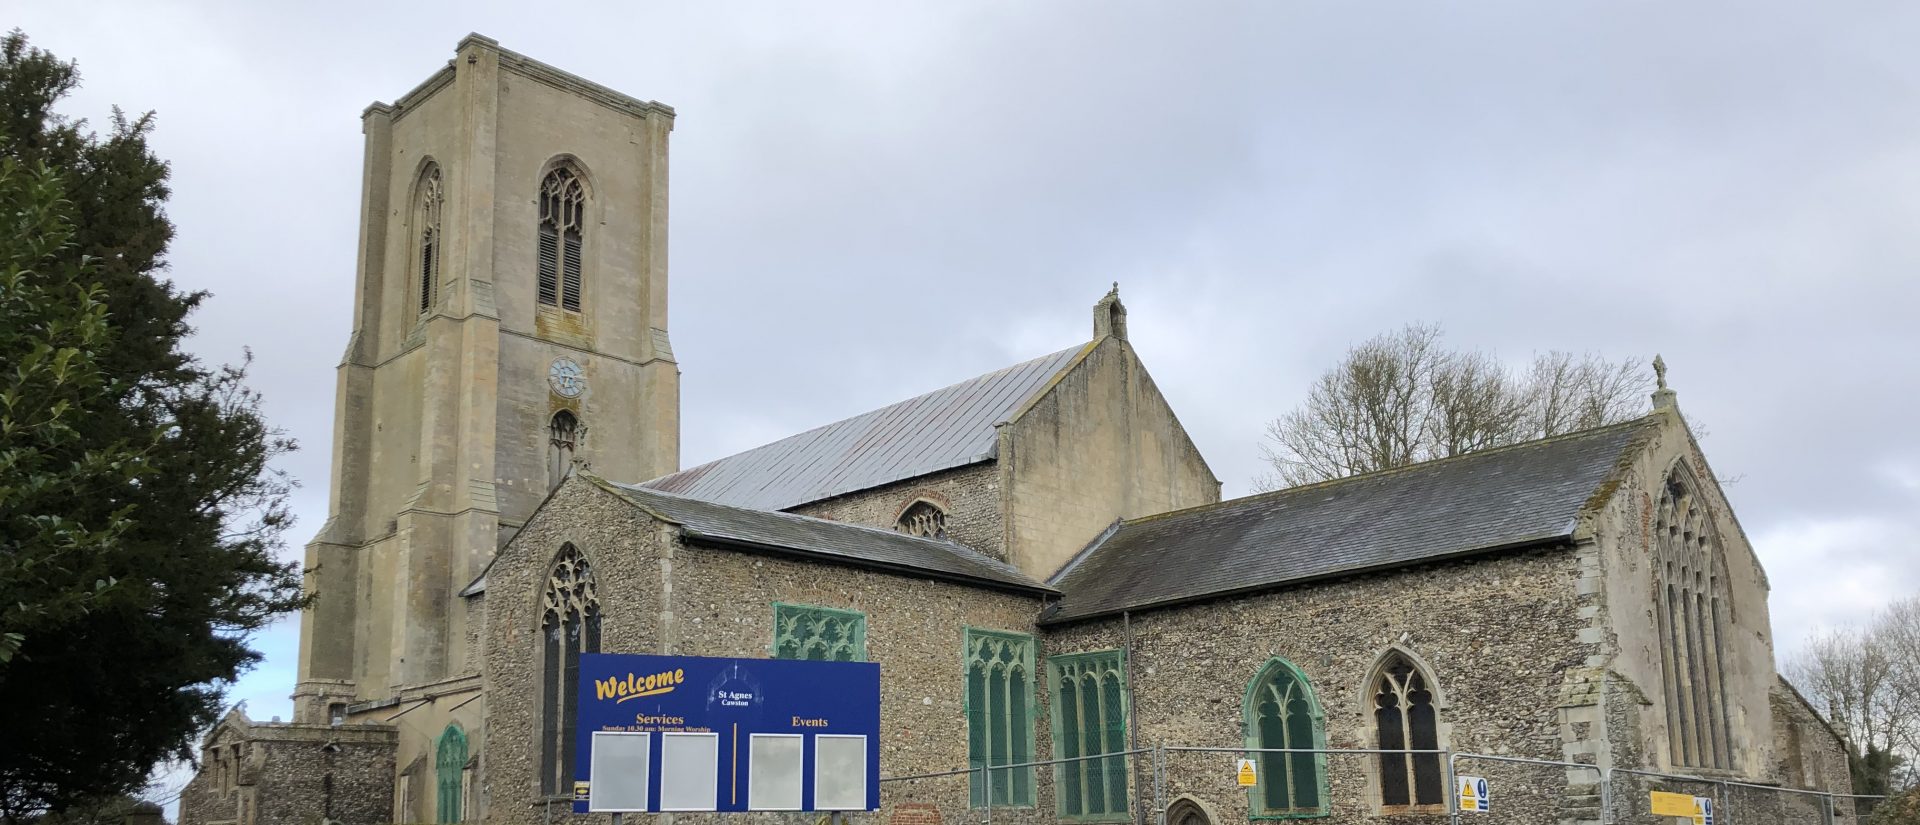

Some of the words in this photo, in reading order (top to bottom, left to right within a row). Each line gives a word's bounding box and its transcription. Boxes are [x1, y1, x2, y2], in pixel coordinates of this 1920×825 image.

[595, 668, 684, 700] Welcome
[719, 690, 727, 699] St
[728, 691, 752, 700] Agnes
[636, 713, 684, 725] Services
[792, 716, 829, 727] Events
